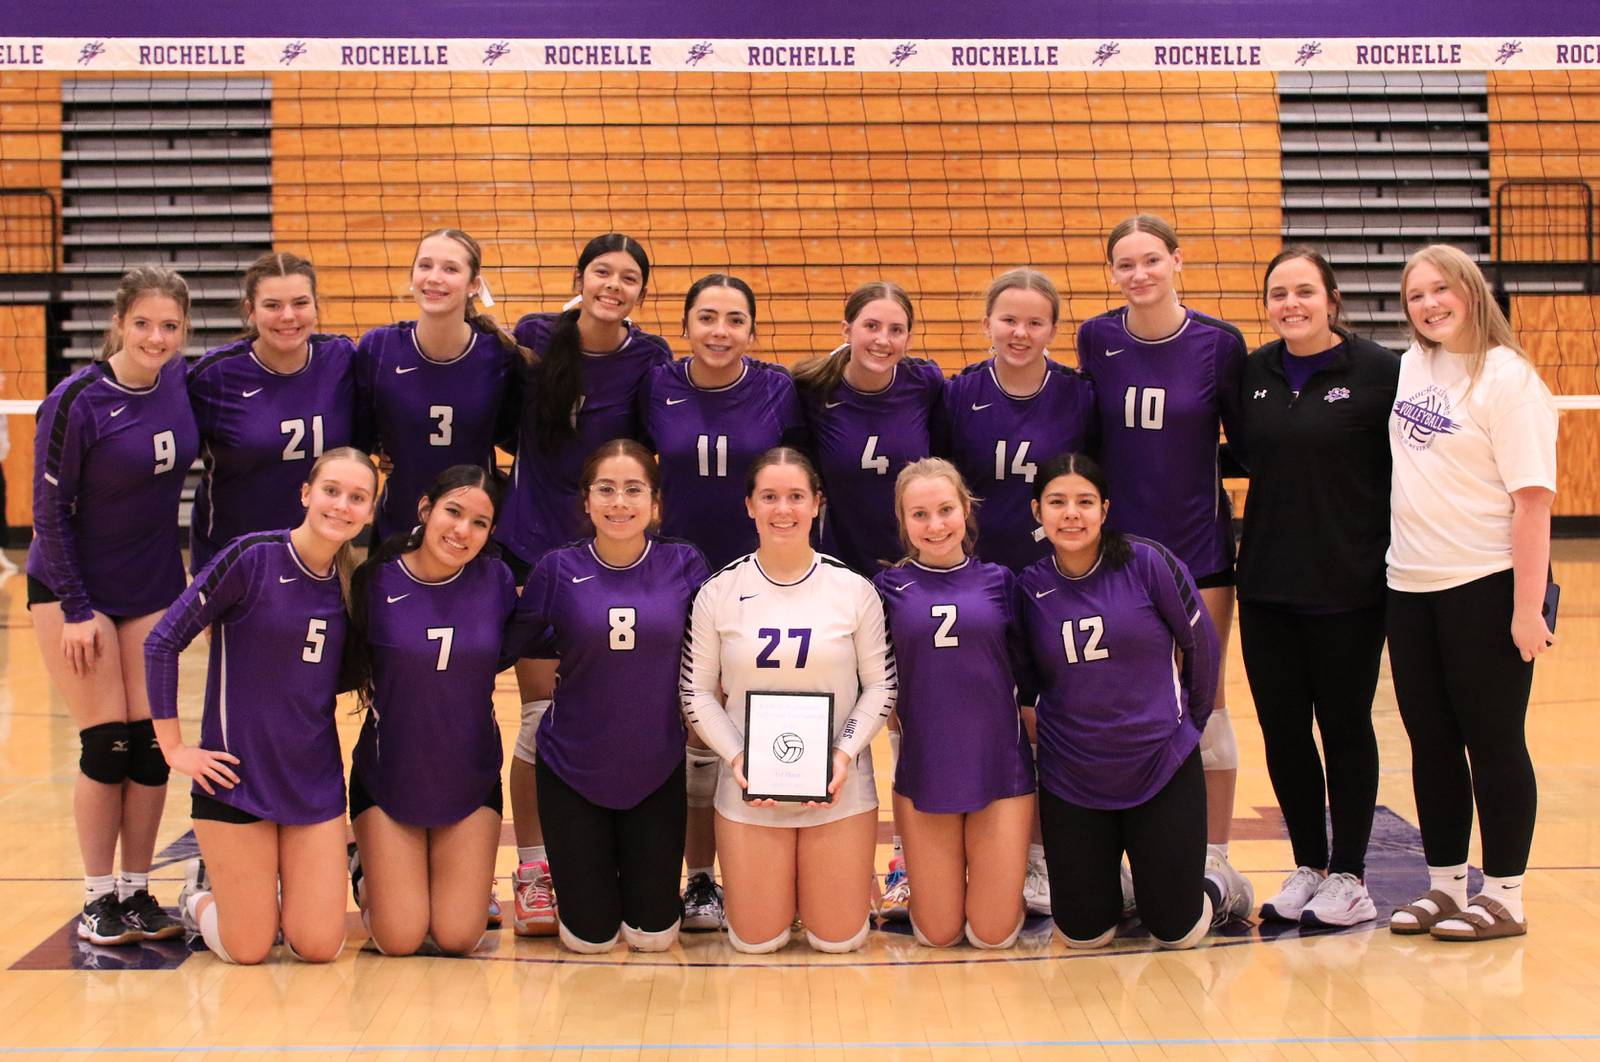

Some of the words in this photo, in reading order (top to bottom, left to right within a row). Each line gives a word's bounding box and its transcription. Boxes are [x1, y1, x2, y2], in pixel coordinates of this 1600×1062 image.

[139, 45, 245, 64] ROCHELLE
[341, 46, 448, 65] ROCHELLE
[545, 46, 651, 65] ROCHELLE
[748, 47, 855, 66] ROCHELLE
[952, 46, 1058, 66] ROCHELLE
[1155, 46, 1260, 65] ROCHELLE
[1356, 44, 1461, 64] ROCHELLE
[429, 405, 453, 446] 3
[1124, 386, 1166, 430] 10
[1399, 402, 1445, 431] VOLLEYBALL
[153, 430, 177, 475] 9
[280, 415, 324, 462] 21
[697, 434, 728, 477] 11
[860, 435, 890, 475] 4
[995, 440, 1038, 483] 14
[302, 618, 328, 664] 5
[608, 607, 636, 651] 8
[931, 603, 960, 649] 2
[1060, 615, 1109, 665] 12
[426, 627, 454, 671] 7
[756, 628, 812, 669] 27
[842, 718, 858, 739] HUBS
